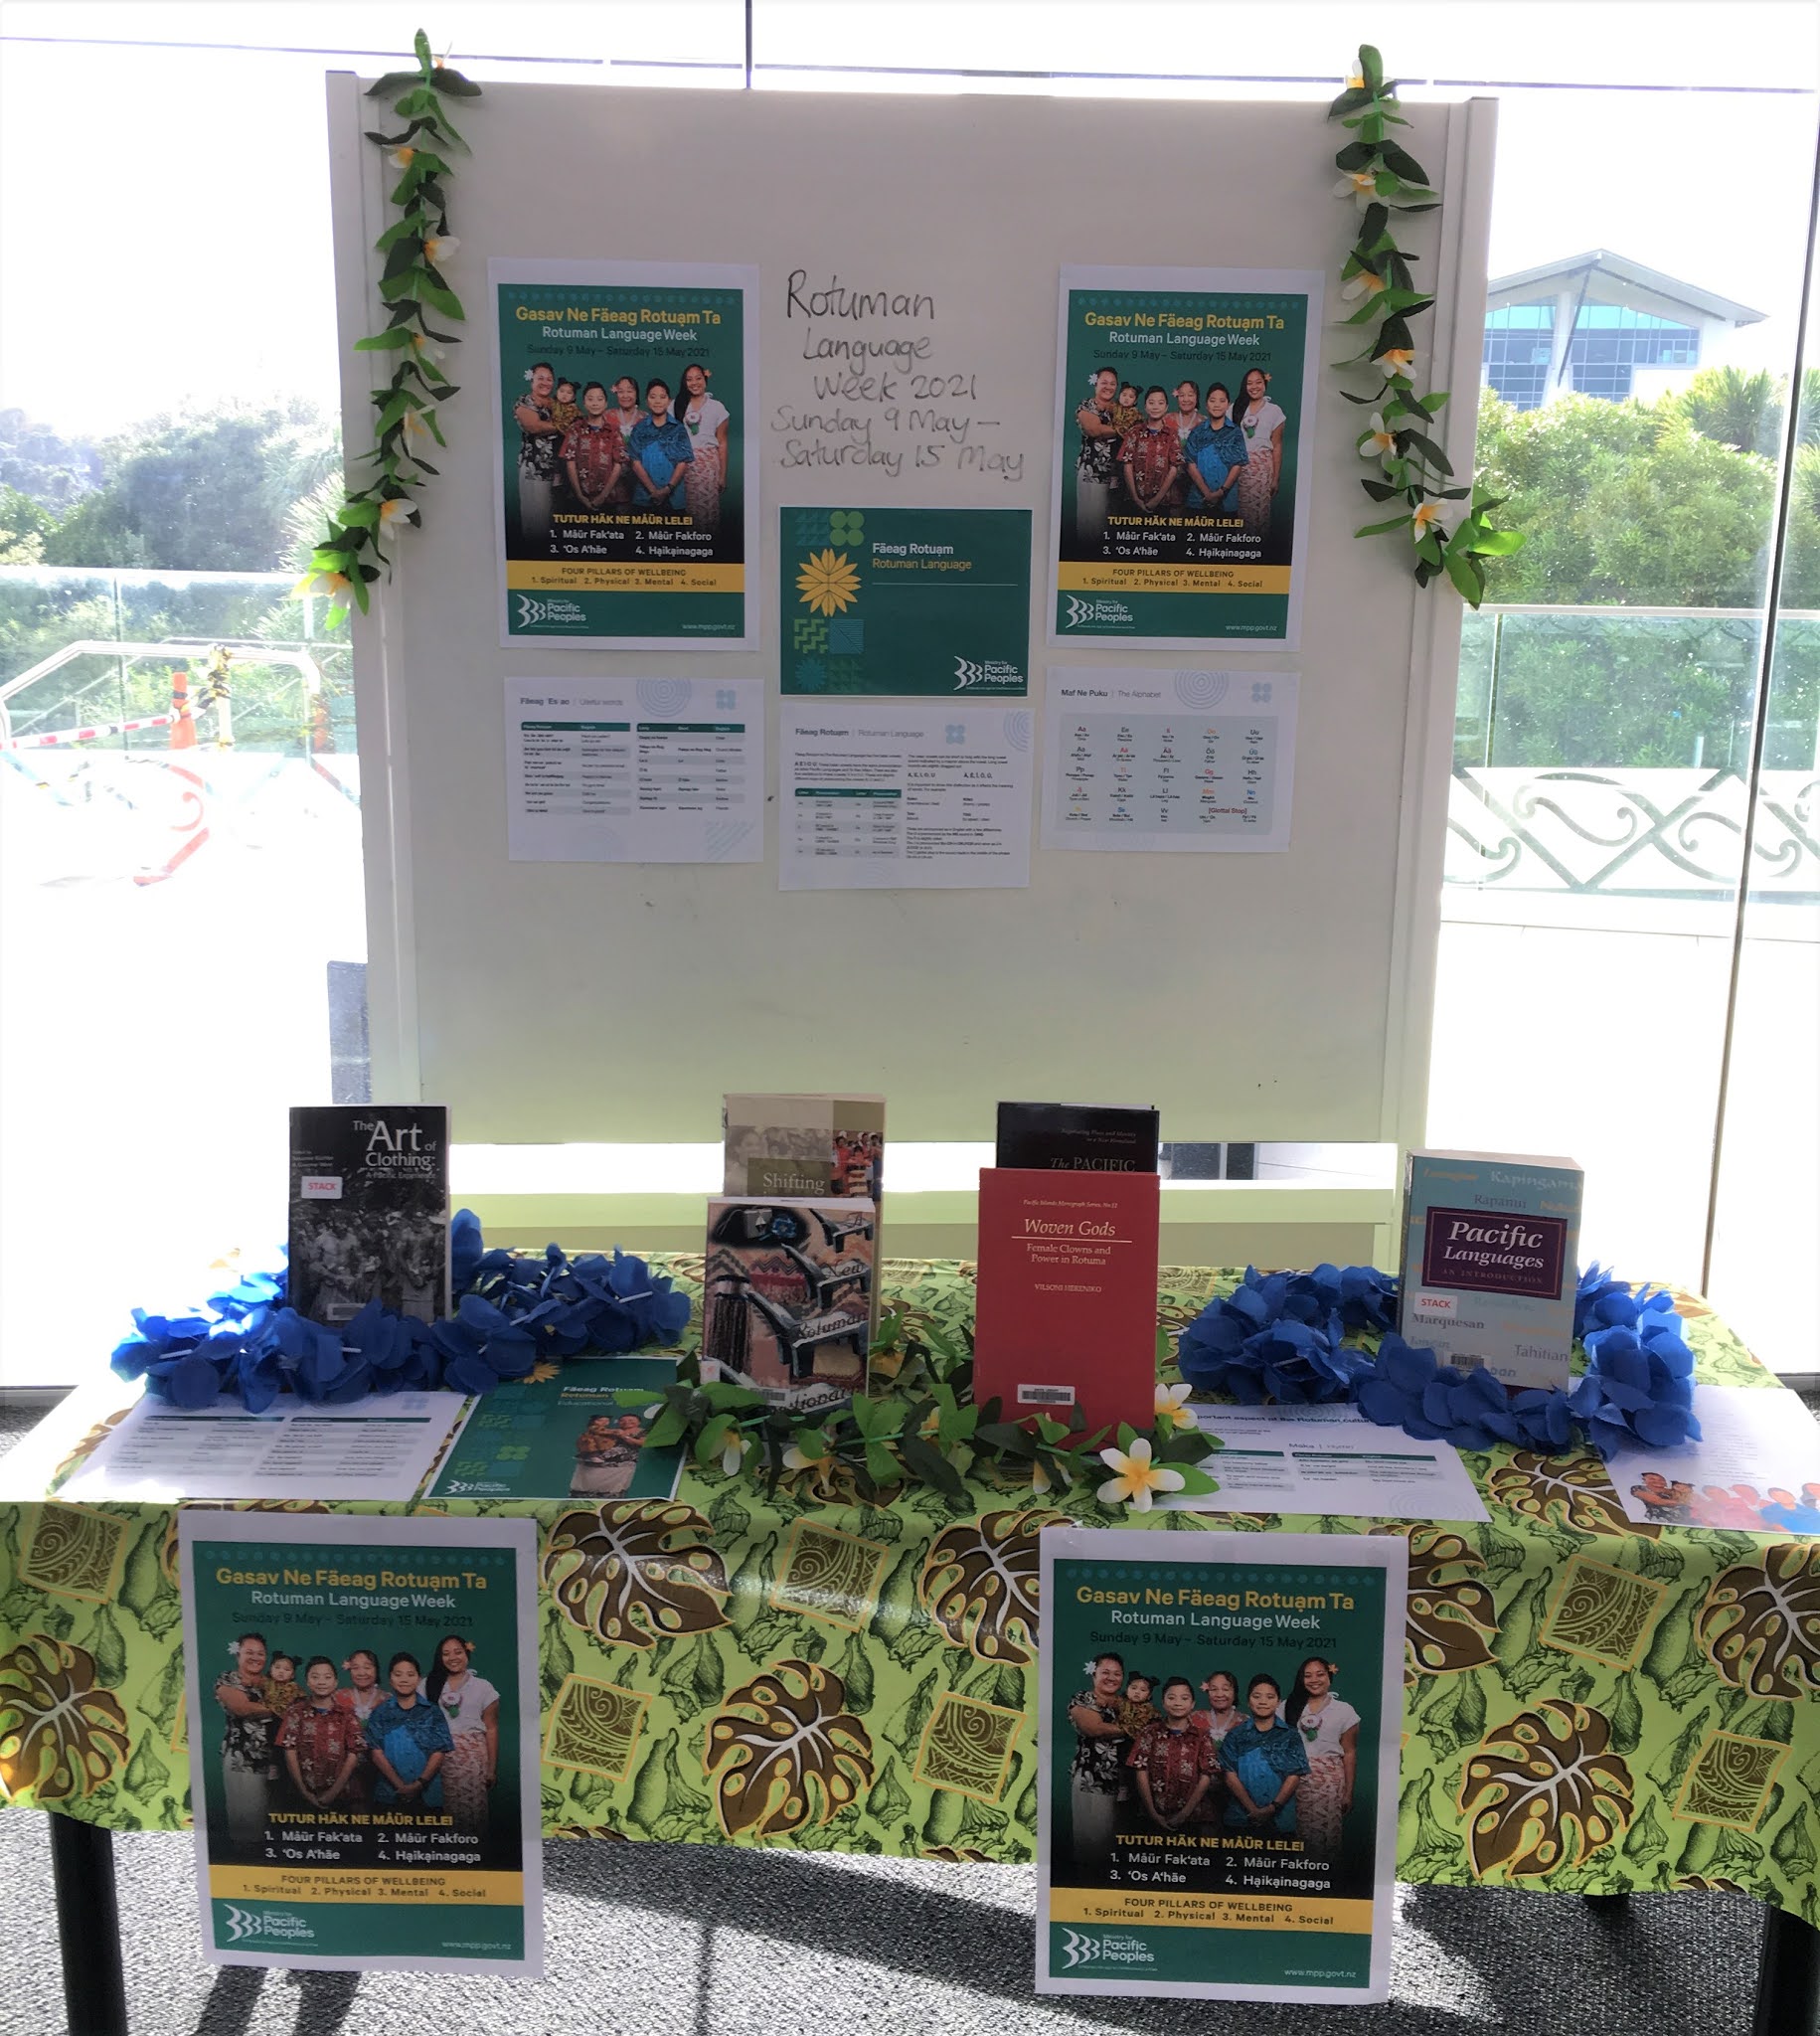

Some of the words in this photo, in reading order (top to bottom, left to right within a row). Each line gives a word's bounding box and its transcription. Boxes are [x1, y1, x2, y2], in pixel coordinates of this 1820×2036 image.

[787, 269, 934, 320] Rotuman
[516, 306, 564, 321] Gasav
[568, 307, 587, 321] Ne
[591, 307, 637, 326] Fäeag
[702, 310, 720, 324] Ta
[1084, 312, 1131, 326] Gasav
[1135, 313, 1155, 326] Ne
[1158, 312, 1204, 331] Fäeag
[1265, 315, 1284, 329] Ta
[543, 326, 596, 338] Rotuman
[601, 327, 661, 343] Language
[664, 328, 697, 340] Week
[1109, 331, 1162, 343] Rotuman
[1166, 333, 1226, 347] Language
[1227, 333, 1259, 345] Week
[803, 327, 932, 377] Language
[814, 372, 898, 403] Week
[910, 374, 976, 401] 2021
[770, 406, 872, 447] Sunday
[885, 407, 899, 431] 9
[910, 409, 970, 444] May
[780, 439, 904, 478] Saturday
[915, 444, 945, 468] 15
[957, 445, 1024, 482] May
[873, 559, 918, 570] Rotuman
[921, 560, 972, 573] Language
[984, 664, 1019, 675] Pacific
[984, 674, 1024, 685] Peoples
[353, 1120, 375, 1131] The
[367, 1120, 423, 1152] Art
[424, 1141, 437, 1152] of
[366, 1152, 436, 1171] Clothing:
[1051, 1157, 1071, 1169] The
[1074, 1156, 1136, 1172] PACIFIC
[763, 1172, 825, 1195] Shifting
[1474, 1194, 1527, 1209] Rapanui
[1024, 1219, 1075, 1234] Woven
[1078, 1221, 1116, 1237] Gods
[1447, 1221, 1544, 1251] Pacific
[1027, 1244, 1059, 1253] Female
[1060, 1245, 1093, 1255] Clowns
[1031, 1254, 1059, 1264] Power
[1061, 1255, 1070, 1265] in
[1072, 1256, 1106, 1266] Rotuma
[1443, 1246, 1545, 1271] Languages
[826, 1260, 865, 1278] New
[1442, 1268, 1456, 1276] AN
[1461, 1271, 1543, 1284] INTRODUCTION
[1035, 1283, 1064, 1292] VILSONI
[1065, 1284, 1102, 1293] HERENIKO
[1421, 1298, 1451, 1309] STACK
[799, 1313, 867, 1338] Rotuman
[1411, 1313, 1485, 1330] Marquesan
[1515, 1344, 1570, 1363] Tahitian
[216, 1568, 278, 1586] Gasav
[284, 1569, 311, 1585] Ne
[316, 1569, 377, 1591] Fäeag
[462, 1573, 486, 1589] Ta
[251, 1591, 323, 1606] Rotuman
[329, 1592, 409, 1611] Language
[412, 1594, 455, 1608] Week
[1076, 1586, 1140, 1605] Gasav
[1145, 1589, 1173, 1605] Ne
[1178, 1588, 1241, 1611] Fäeag
[1328, 1593, 1354, 1610] Ta
[1111, 1611, 1184, 1625] Rotuman
[1190, 1612, 1272, 1631] Language
[1275, 1614, 1320, 1629] Week
[1090, 1631, 1138, 1645] Sunday
[1142, 1633, 1150, 1643] 9
[1154, 1633, 1182, 1646] May
[1197, 1634, 1255, 1648] Saturday
[1259, 1636, 1272, 1646] 15
[1276, 1636, 1304, 1649] May
[1306, 1637, 1336, 1648] 2021
[1115, 1834, 1163, 1845] TUTUR
[1200, 1837, 1219, 1847] NE
[1266, 1840, 1304, 1851] LELEI
[1110, 1852, 1119, 1862] 1.
[1226, 1856, 1237, 1866] 2.
[1280, 1858, 1329, 1870] Fakforo
[1109, 1870, 1121, 1879] 3.
[1225, 1874, 1237, 1884] 4.
[1124, 1898, 1154, 1907] FOUR
[1158, 1899, 1205, 1909] PILLARS
[1209, 1901, 1224, 1910] OF
[1228, 1902, 1292, 1912] WELLBEING
[1095, 1909, 1143, 1920] Spiritual
[1168, 1911, 1215, 1922] Physical
[1299, 1916, 1333, 1925] Social
[1102, 1939, 1146, 1951] Pacific
[1102, 1950, 1154, 1963] Peoples
[1284, 1967, 1356, 1978] www.mpp.govt.nz
